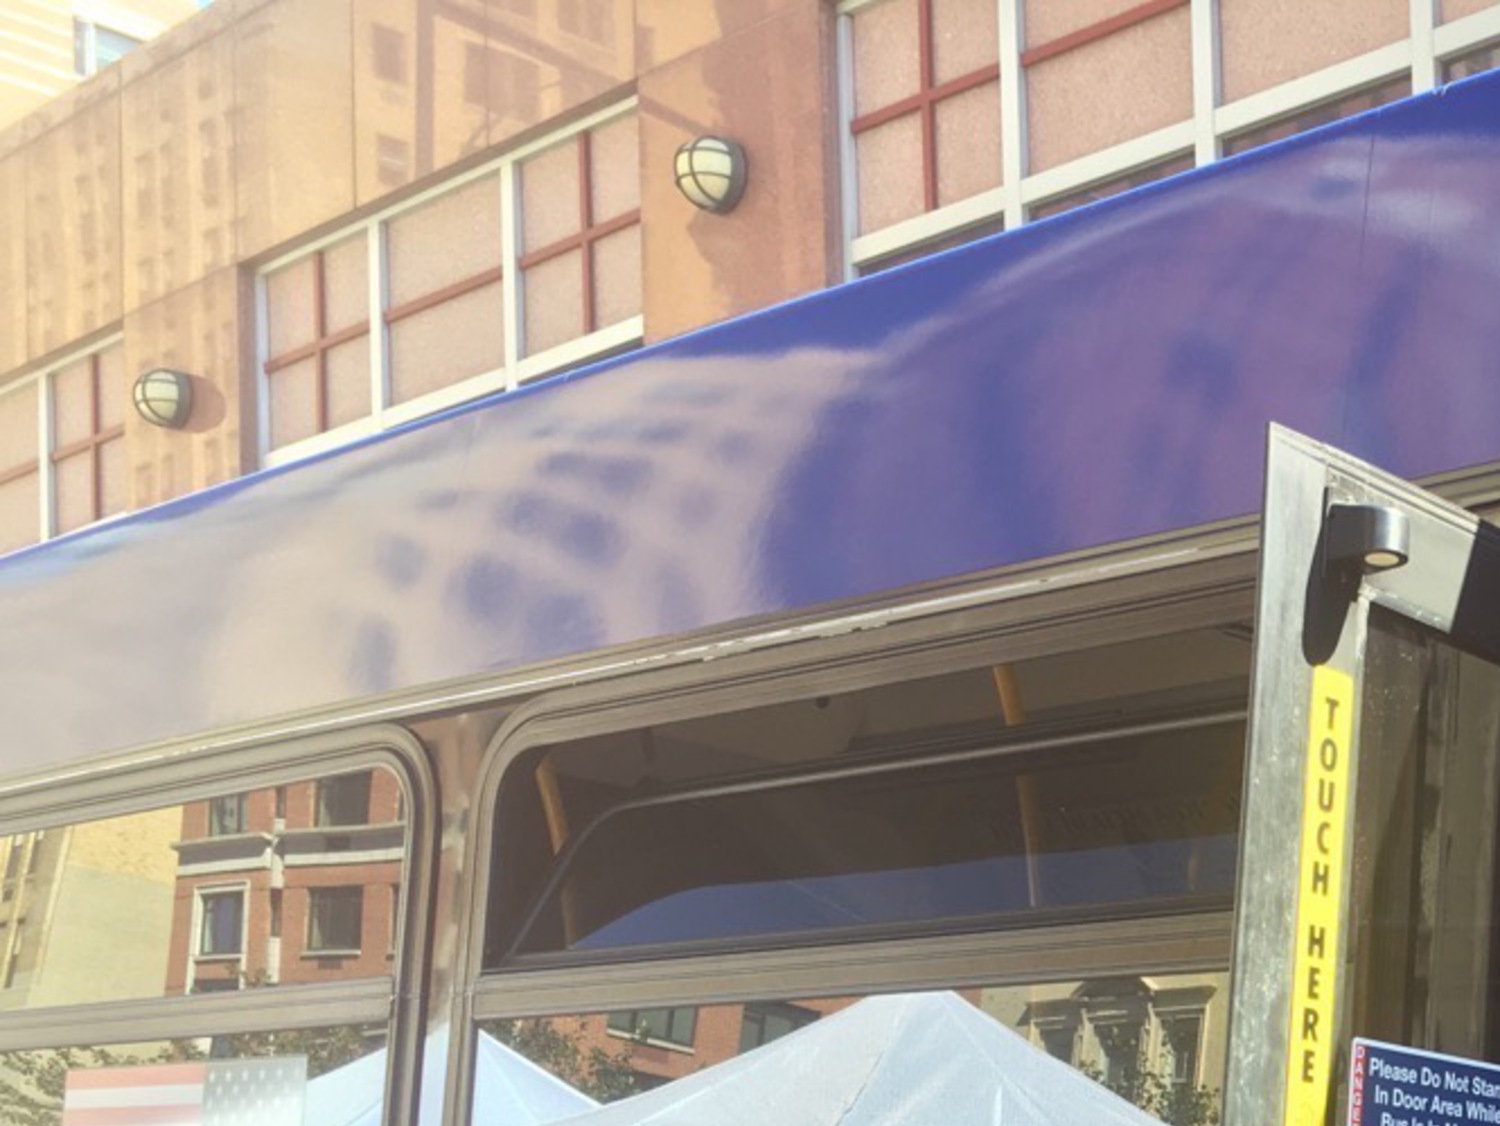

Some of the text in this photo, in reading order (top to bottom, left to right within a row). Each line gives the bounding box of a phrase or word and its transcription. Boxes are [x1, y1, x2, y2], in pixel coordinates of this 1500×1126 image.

[1311, 697, 1340, 896] TOUCH
[1301, 924, 1326, 1084] HERE
[1369, 1057, 1416, 1083] Please
[1420, 1066, 1441, 1086] Do
[1444, 1071, 1469, 1092] Not
[1375, 1085, 1389, 1105] In
[1393, 1088, 1427, 1110] Door
[1430, 1095, 1462, 1117] Area
